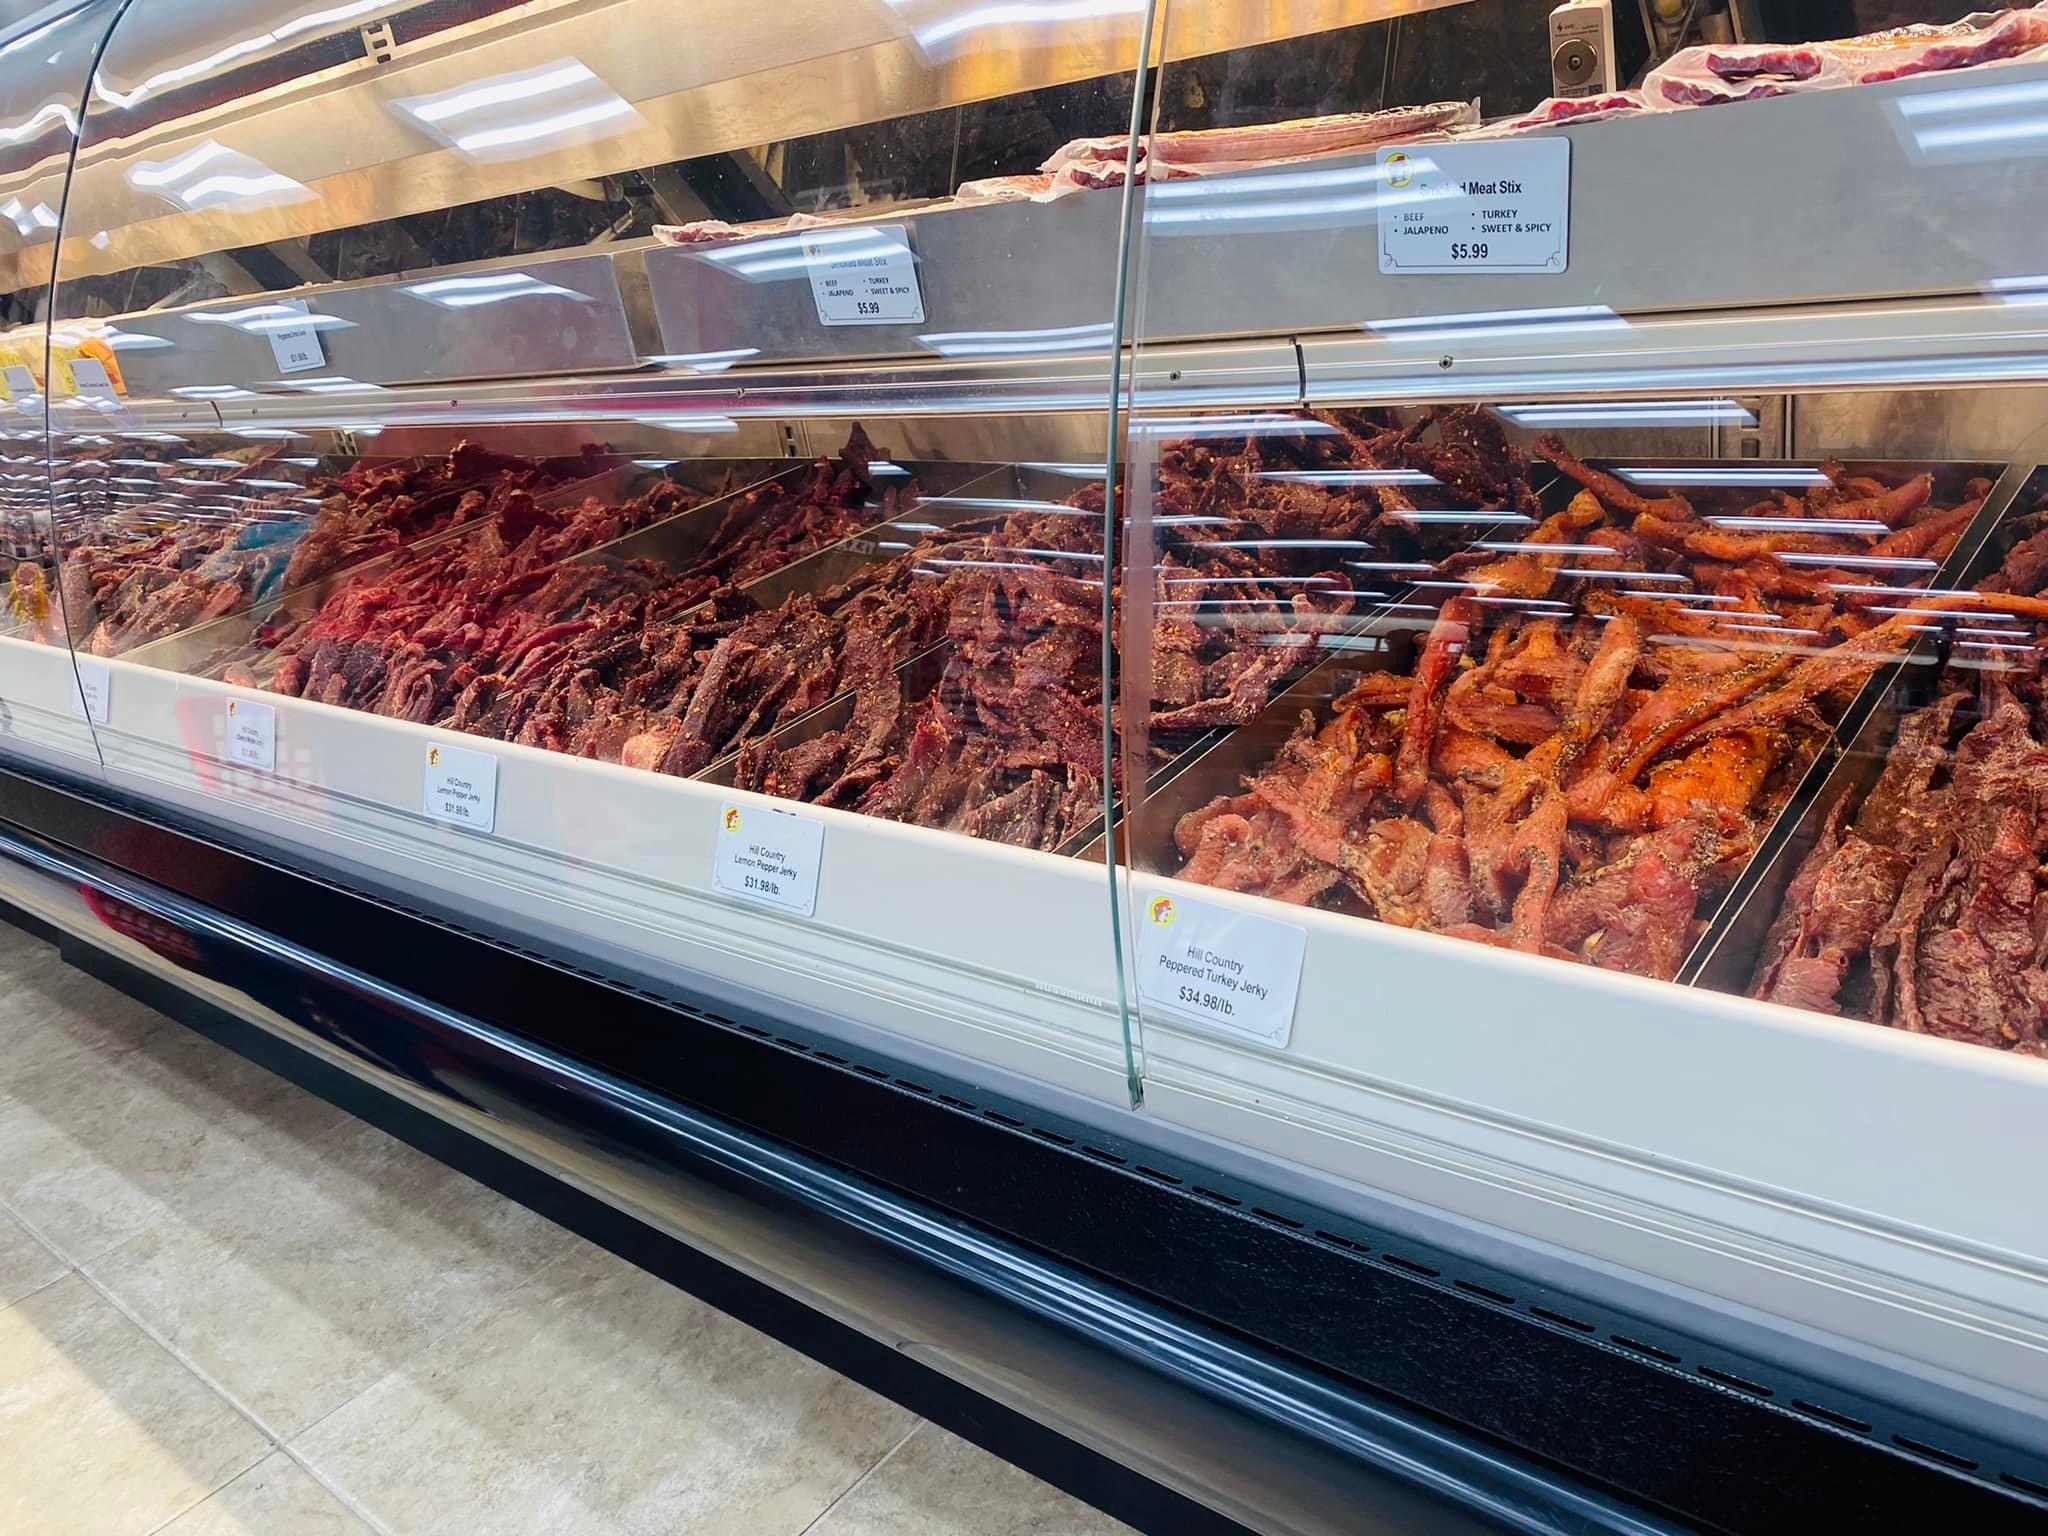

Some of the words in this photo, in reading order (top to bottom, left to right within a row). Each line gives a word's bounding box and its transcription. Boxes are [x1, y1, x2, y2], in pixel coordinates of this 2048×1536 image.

[1469, 181, 1497, 195] Meat
[1500, 180, 1521, 194] Stix
[1403, 213, 1424, 222] BEEF
[1482, 209, 1518, 219] TURKEY
[1403, 226, 1449, 235] JALAPENO
[1482, 224, 1512, 233] SWEET
[1515, 224, 1522, 232] &
[1525, 223, 1551, 232] SPICY
[1451, 243, 1488, 259] $5.99
[858, 302, 879, 314] $5.99
[749, 844, 759, 855] Hill
[761, 847, 786, 864] Country
[735, 854, 756, 867] Lemon
[757, 859, 779, 874] Pepper
[780, 867, 798, 880] Jerky
[744, 875, 780, 895] $31.98/lb.
[1187, 946, 1203, 960] Hill
[1205, 951, 1244, 975] Country
[1159, 955, 1204, 978] Peppered
[1207, 969, 1239, 991] Turkey
[1240, 982, 1268, 1000] Jerky
[1179, 986, 1235, 1016] $34.98/lb.
